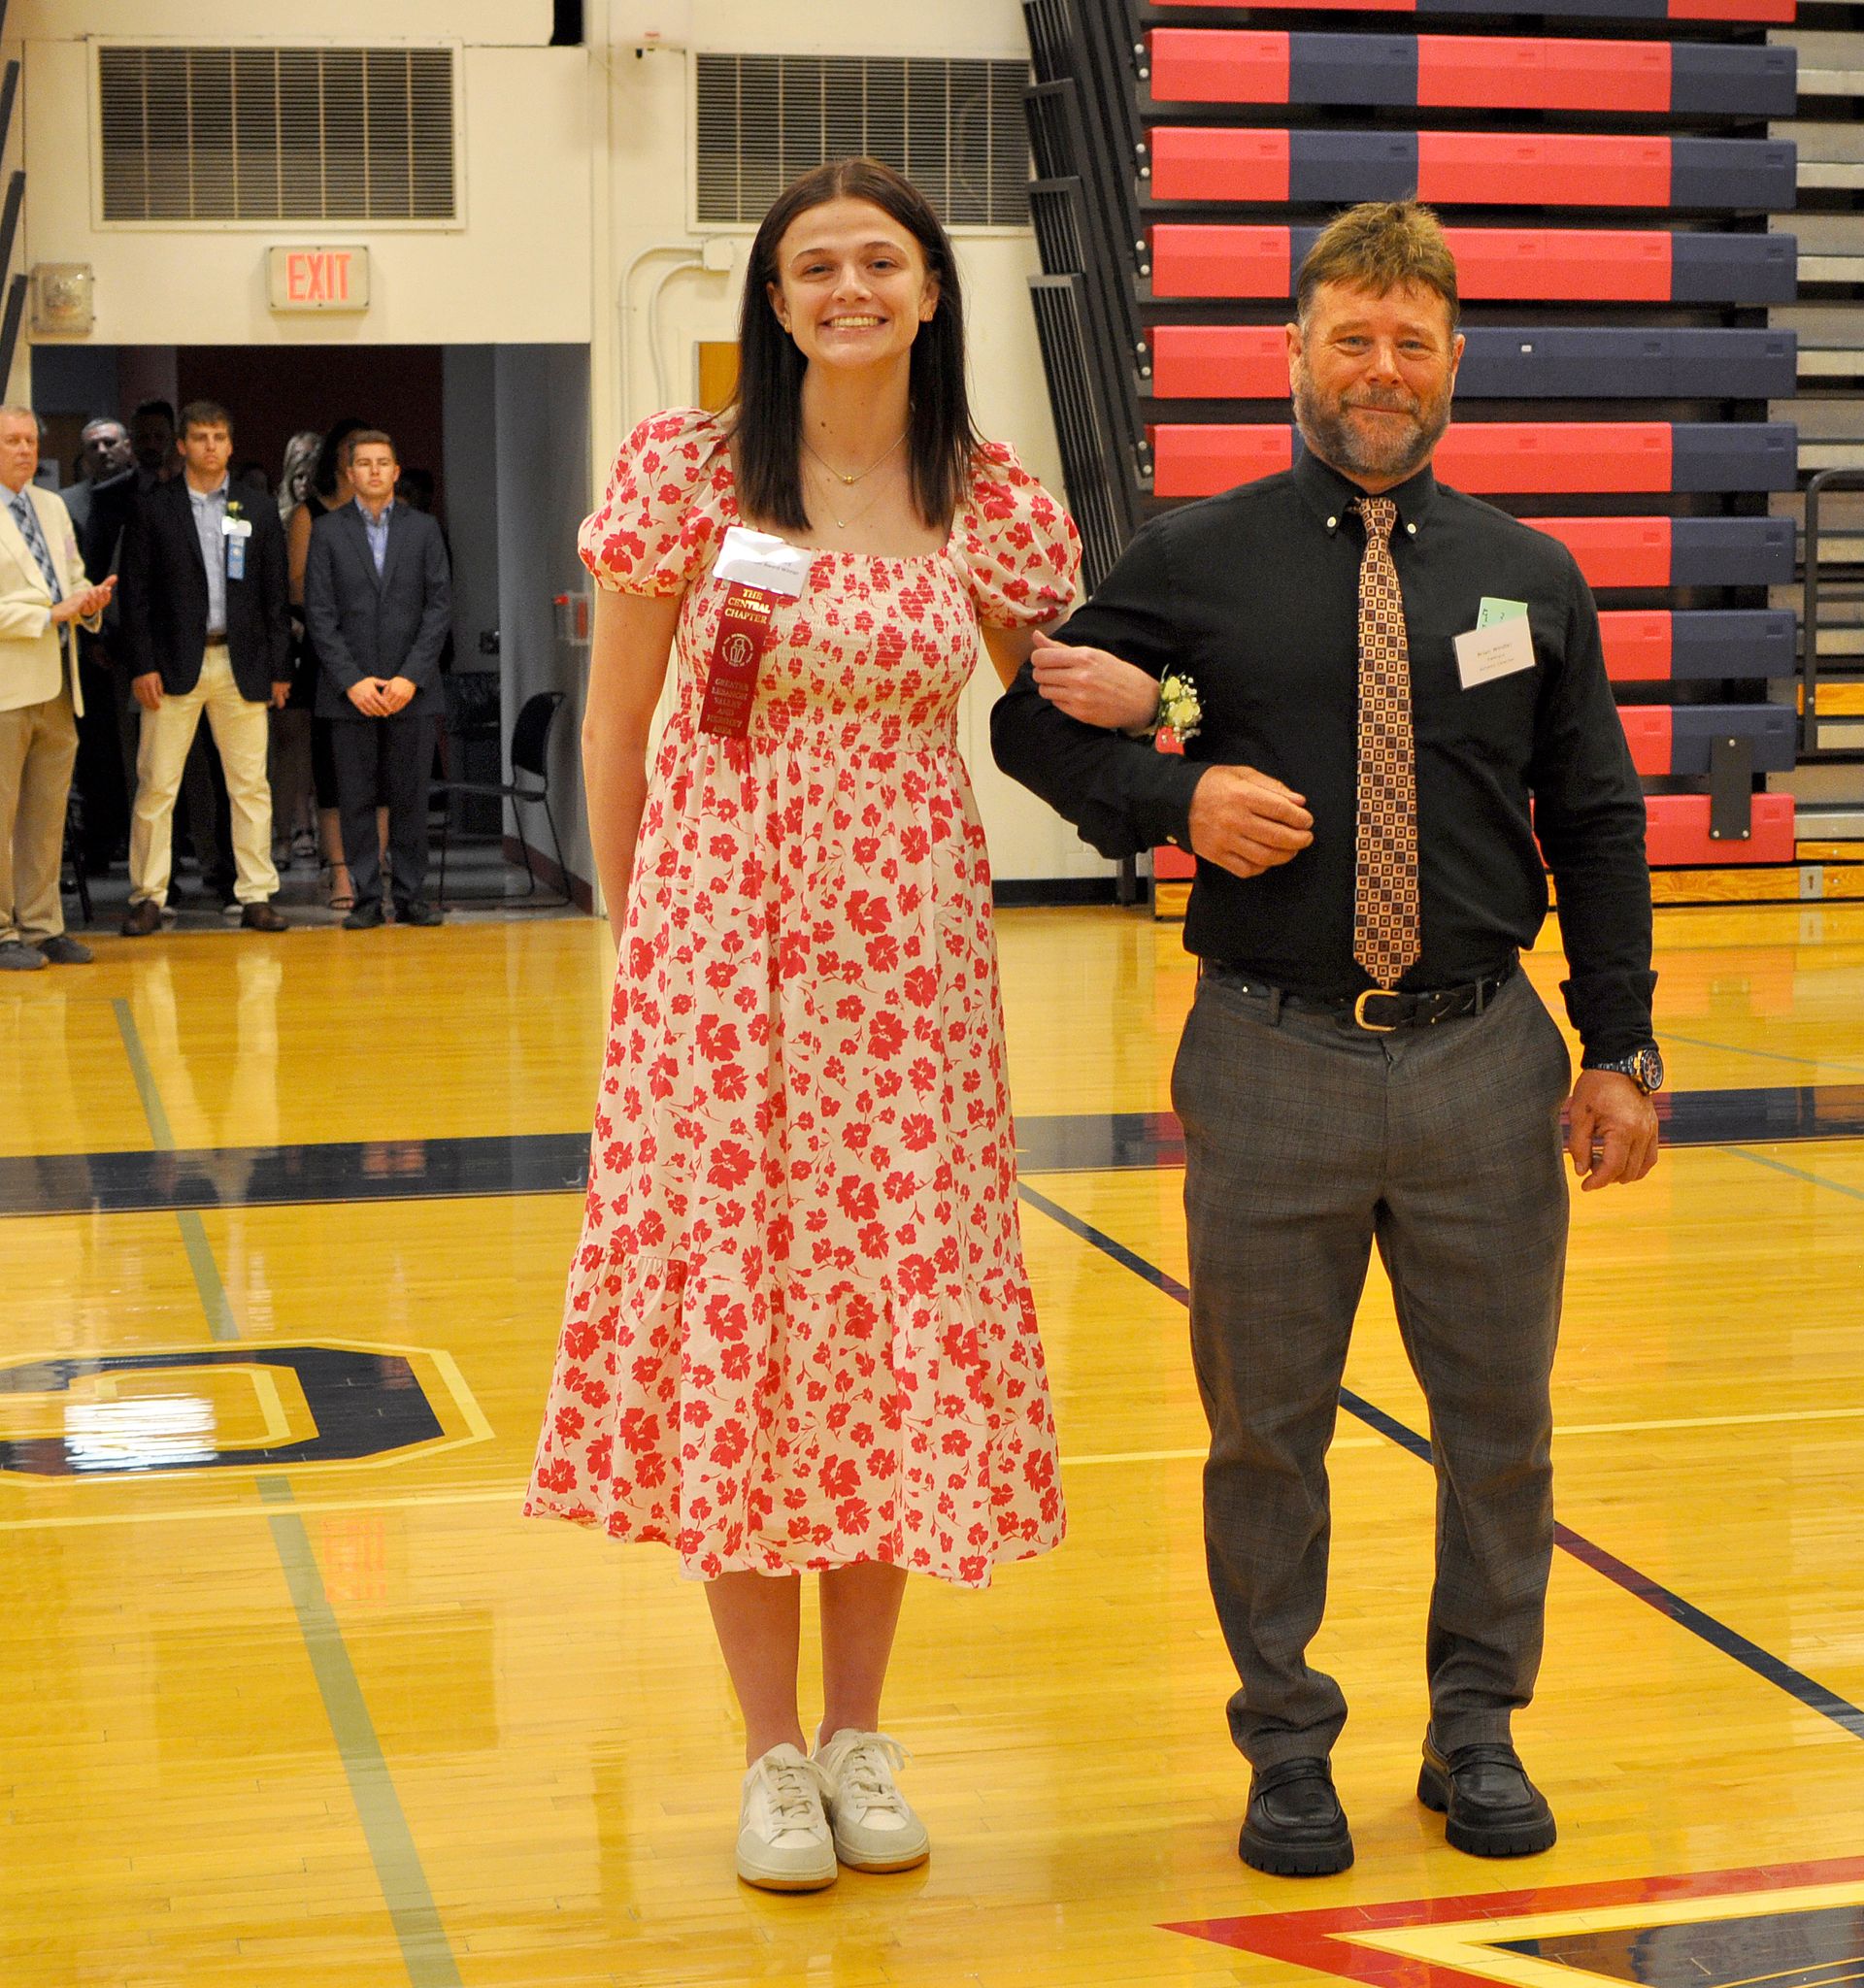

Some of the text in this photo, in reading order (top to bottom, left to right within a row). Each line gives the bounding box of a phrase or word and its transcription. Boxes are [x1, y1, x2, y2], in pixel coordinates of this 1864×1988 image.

[287, 252, 351, 302] EXIT
[743, 588, 763, 600] THE
[727, 597, 771, 613] CENTRAL
[724, 608, 768, 624] CHAPTER
